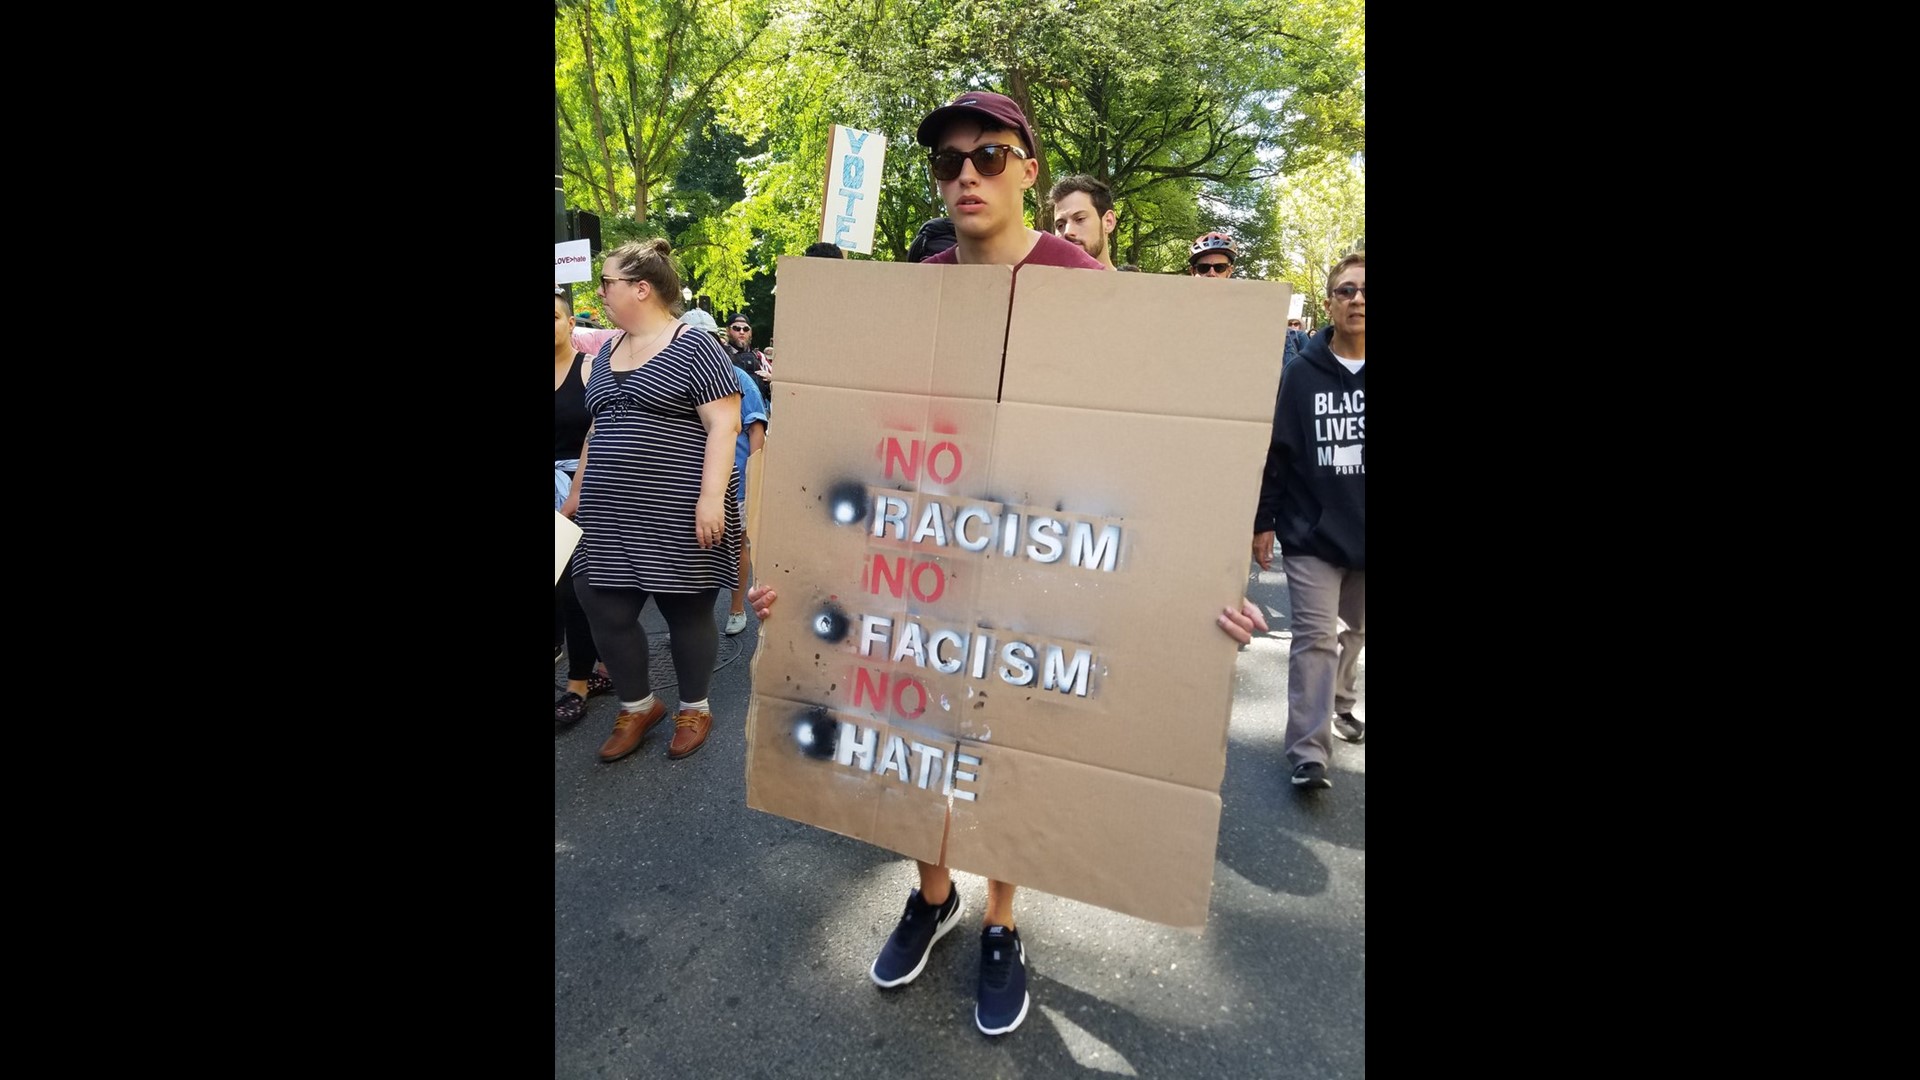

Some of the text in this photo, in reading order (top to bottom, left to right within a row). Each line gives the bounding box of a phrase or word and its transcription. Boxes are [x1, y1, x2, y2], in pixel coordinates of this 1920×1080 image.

[835, 128, 869, 249] VOTE
[884, 437, 963, 485] NO
[873, 494, 1122, 573] RACISM
[871, 553, 946, 604] NO
[853, 667, 928, 719] NO
[860, 614, 1093, 697] FACISM
[835, 722, 983, 801] HATE
